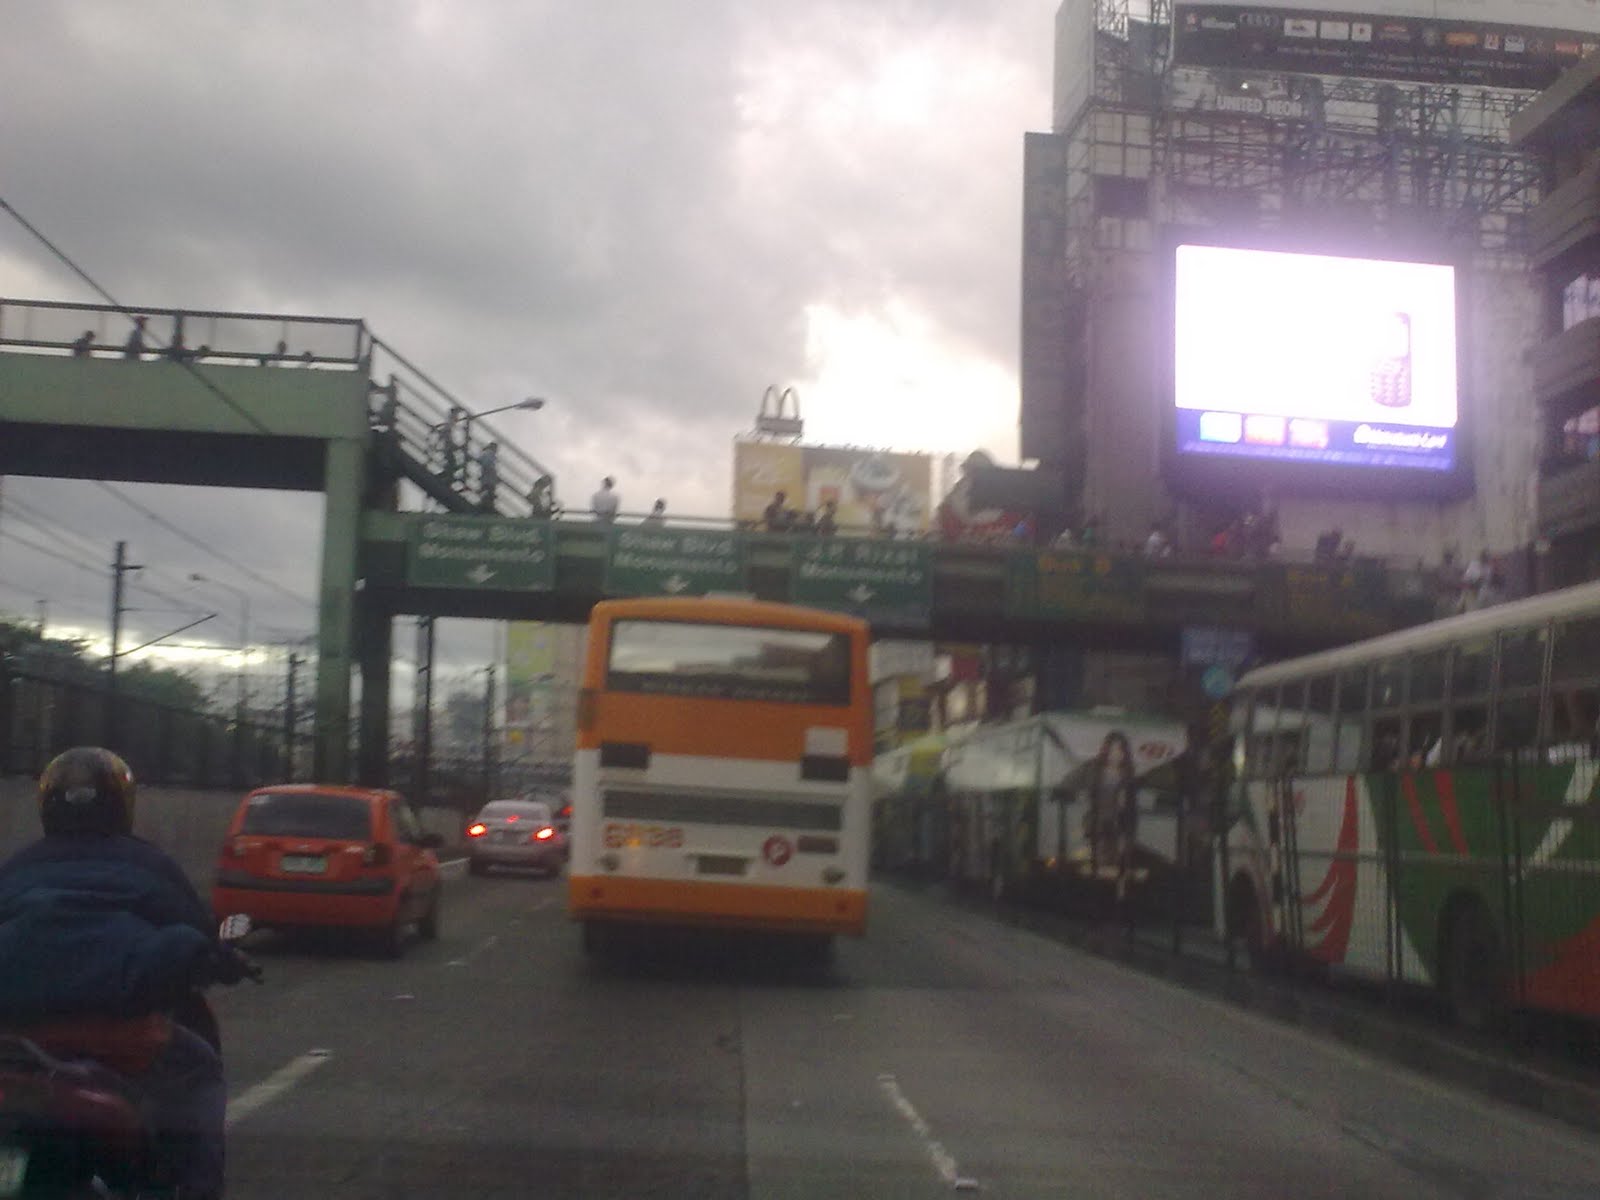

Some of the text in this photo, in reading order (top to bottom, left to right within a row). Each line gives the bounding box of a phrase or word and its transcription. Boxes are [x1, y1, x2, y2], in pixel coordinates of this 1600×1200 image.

[1216, 96, 1303, 117] UNITED NEON
[417, 542, 546, 563] Monumento
[613, 552, 738, 575] Monumento
[800, 562, 923, 584] Monumento
